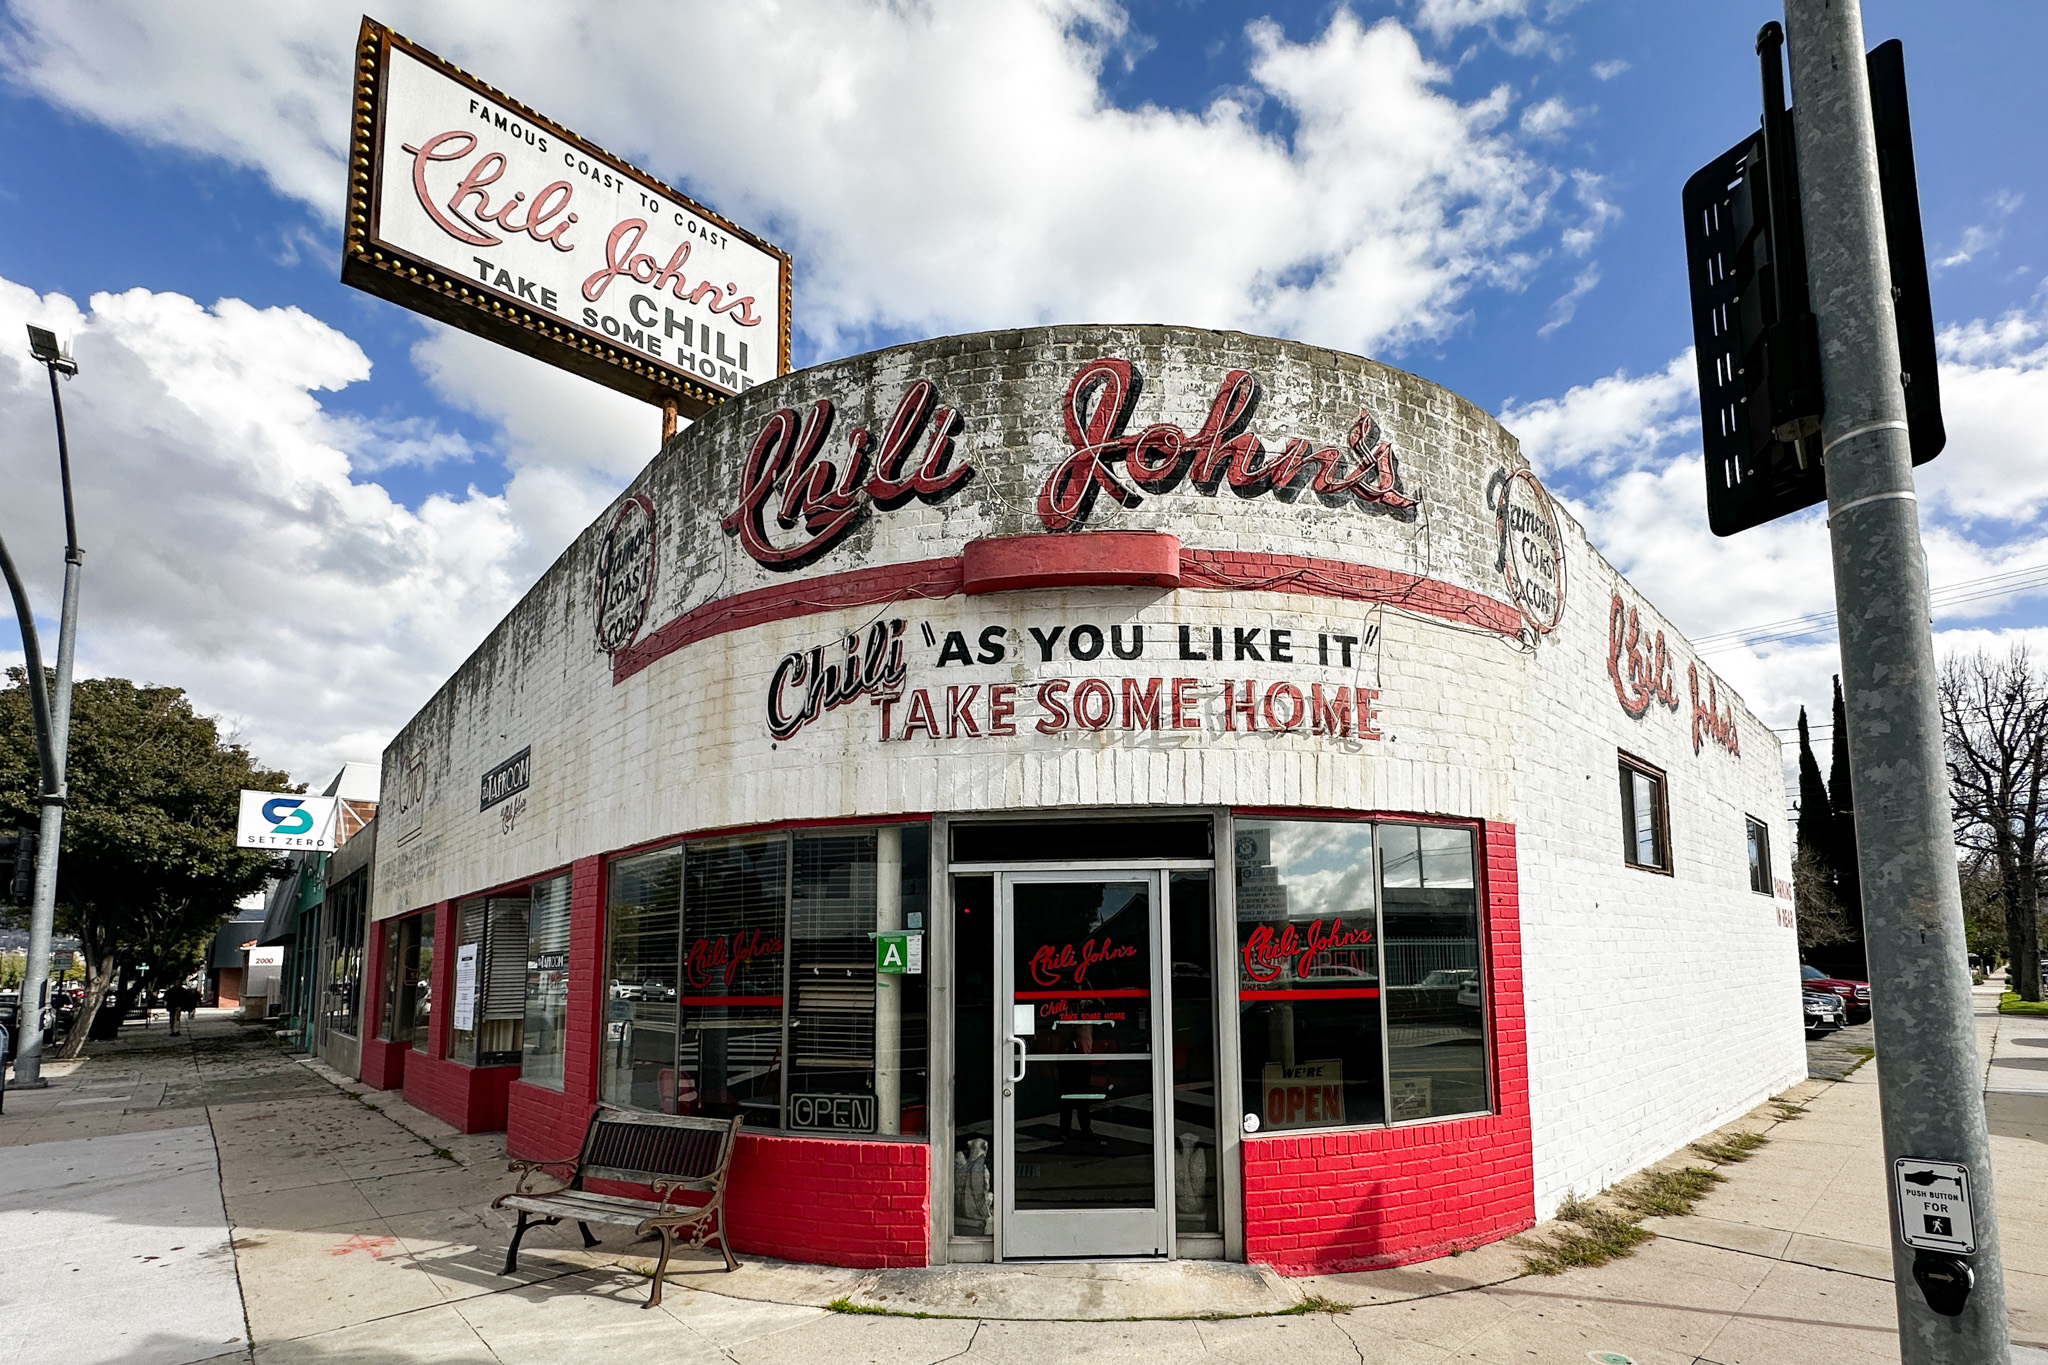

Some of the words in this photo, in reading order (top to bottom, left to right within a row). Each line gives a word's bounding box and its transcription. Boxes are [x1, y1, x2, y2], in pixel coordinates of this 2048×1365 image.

[469, 99, 548, 153] FAMOUS
[564, 153, 624, 194] COAST
[640, 192, 659, 213] TO
[674, 213, 728, 250] COAST
[401, 131, 579, 252] Chili
[582, 219, 762, 326] John's
[473, 256, 558, 312] TAKE
[582, 307, 661, 357] SOME
[678, 347, 754, 391] HOME
[629, 294, 748, 372] CHILI
[721, 379, 976, 571] Chili
[1522, 536, 1556, 583] COAST
[1526, 578, 1557, 622] COAST
[766, 618, 908, 741] Chili
[1027, 624, 1145, 664] YOU
[1178, 625, 1294, 663] LIKE
[1606, 594, 1679, 720] Chili
[870, 680, 1017, 742] TAKE
[1035, 678, 1201, 735] SOME
[1224, 679, 1383, 741] HOME
[247, 835, 276, 844] SET
[286, 838, 325, 847] ZERO
[255, 957, 274, 965] 2000
[686, 938, 729, 988] Chili
[724, 928, 784, 986] John's
[883, 943, 902, 966] A
[1028, 944, 1078, 986] Chili
[1074, 937, 1137, 983] John's
[1240, 925, 1302, 982] Chili
[1297, 917, 1373, 978] John's
[1040, 999, 1069, 1017] Chili
[1104, 1012, 1126, 1020] HOME
[1282, 1066, 1324, 1079] WE'RE
[795, 1098, 869, 1128] OPEN
[1268, 1084, 1340, 1125] OPEN
[1906, 1189, 1927, 1198] PUSH
[1929, 1192, 1959, 1201] BUTTON
[1924, 1202, 1948, 1213] FOR
